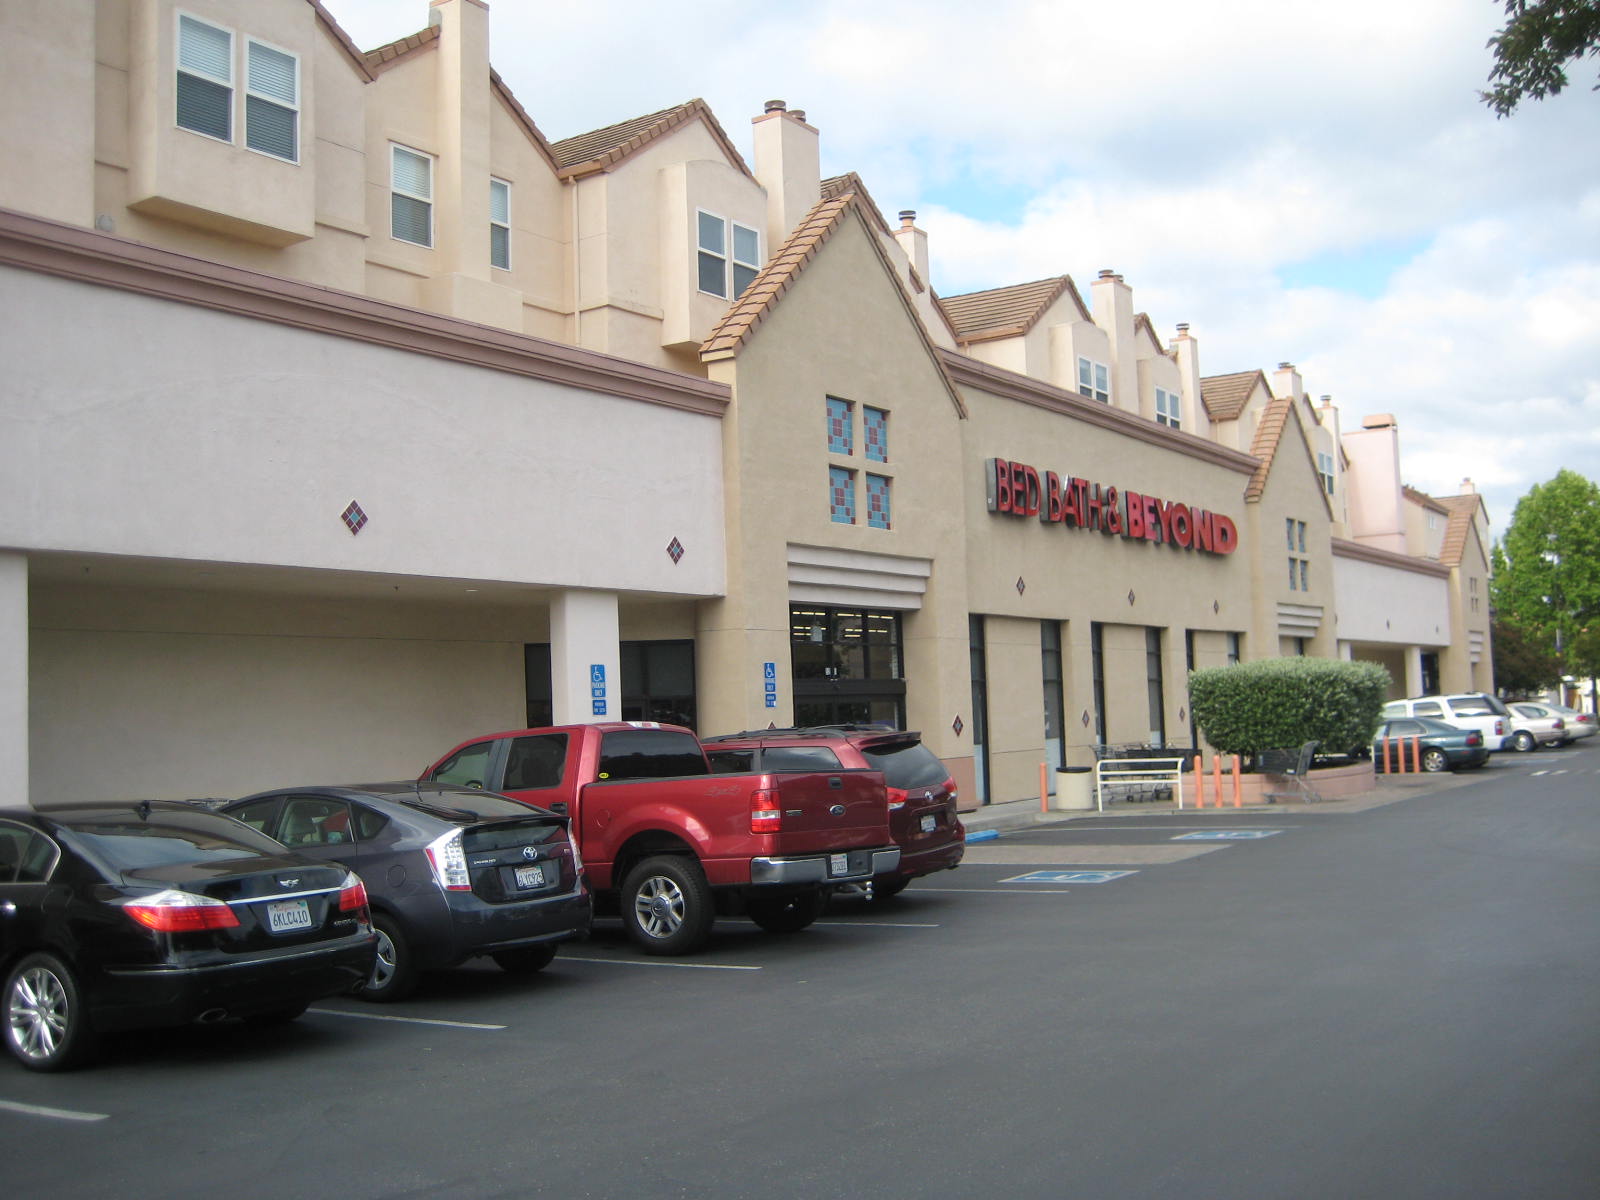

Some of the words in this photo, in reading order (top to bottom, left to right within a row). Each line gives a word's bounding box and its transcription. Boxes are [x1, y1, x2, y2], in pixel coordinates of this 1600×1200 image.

[987, 458, 1041, 517] BED
[1042, 471, 1103, 532] BATH
[1102, 485, 1122, 535] &
[1122, 490, 1239, 555] BEYOND
